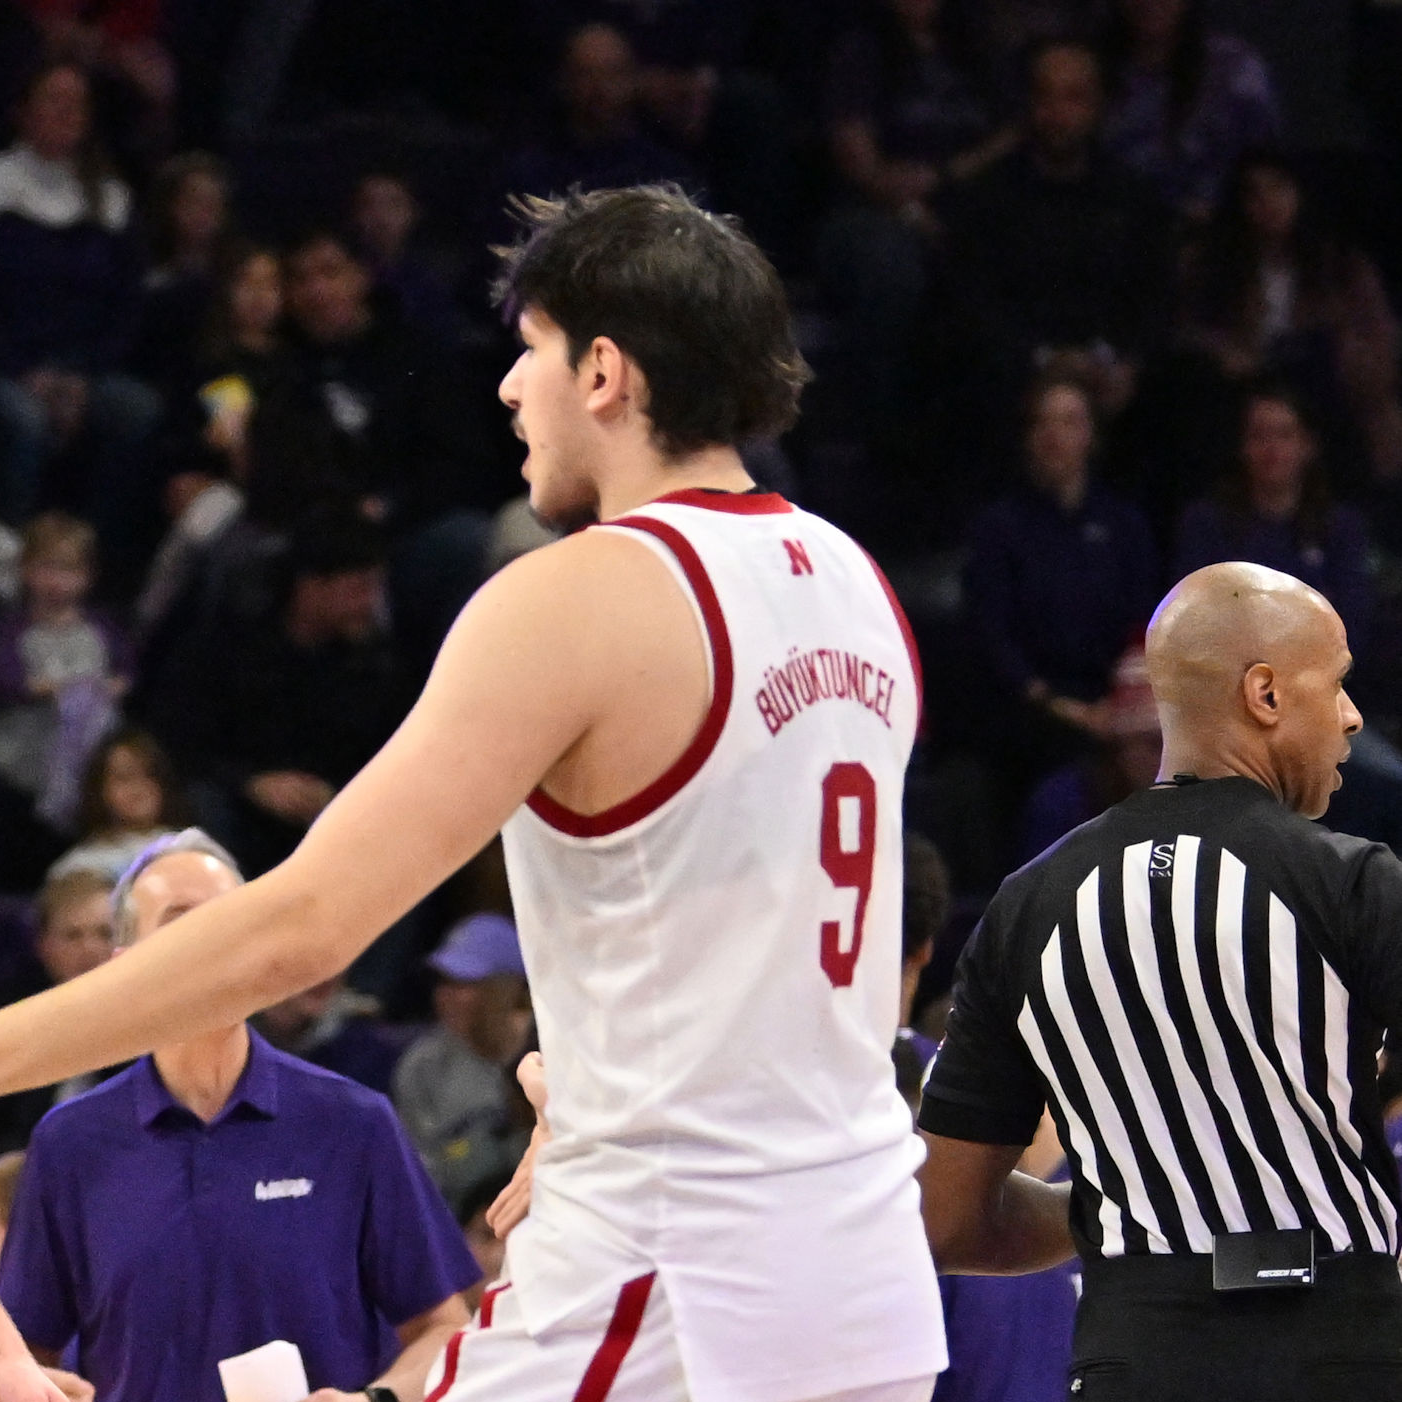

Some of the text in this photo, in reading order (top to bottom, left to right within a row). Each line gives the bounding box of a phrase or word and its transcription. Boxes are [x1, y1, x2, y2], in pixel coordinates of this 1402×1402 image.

[782, 538, 814, 576] N
[756, 646, 895, 737] BÜYÜKTUNCEL
[821, 761, 878, 989] 9
